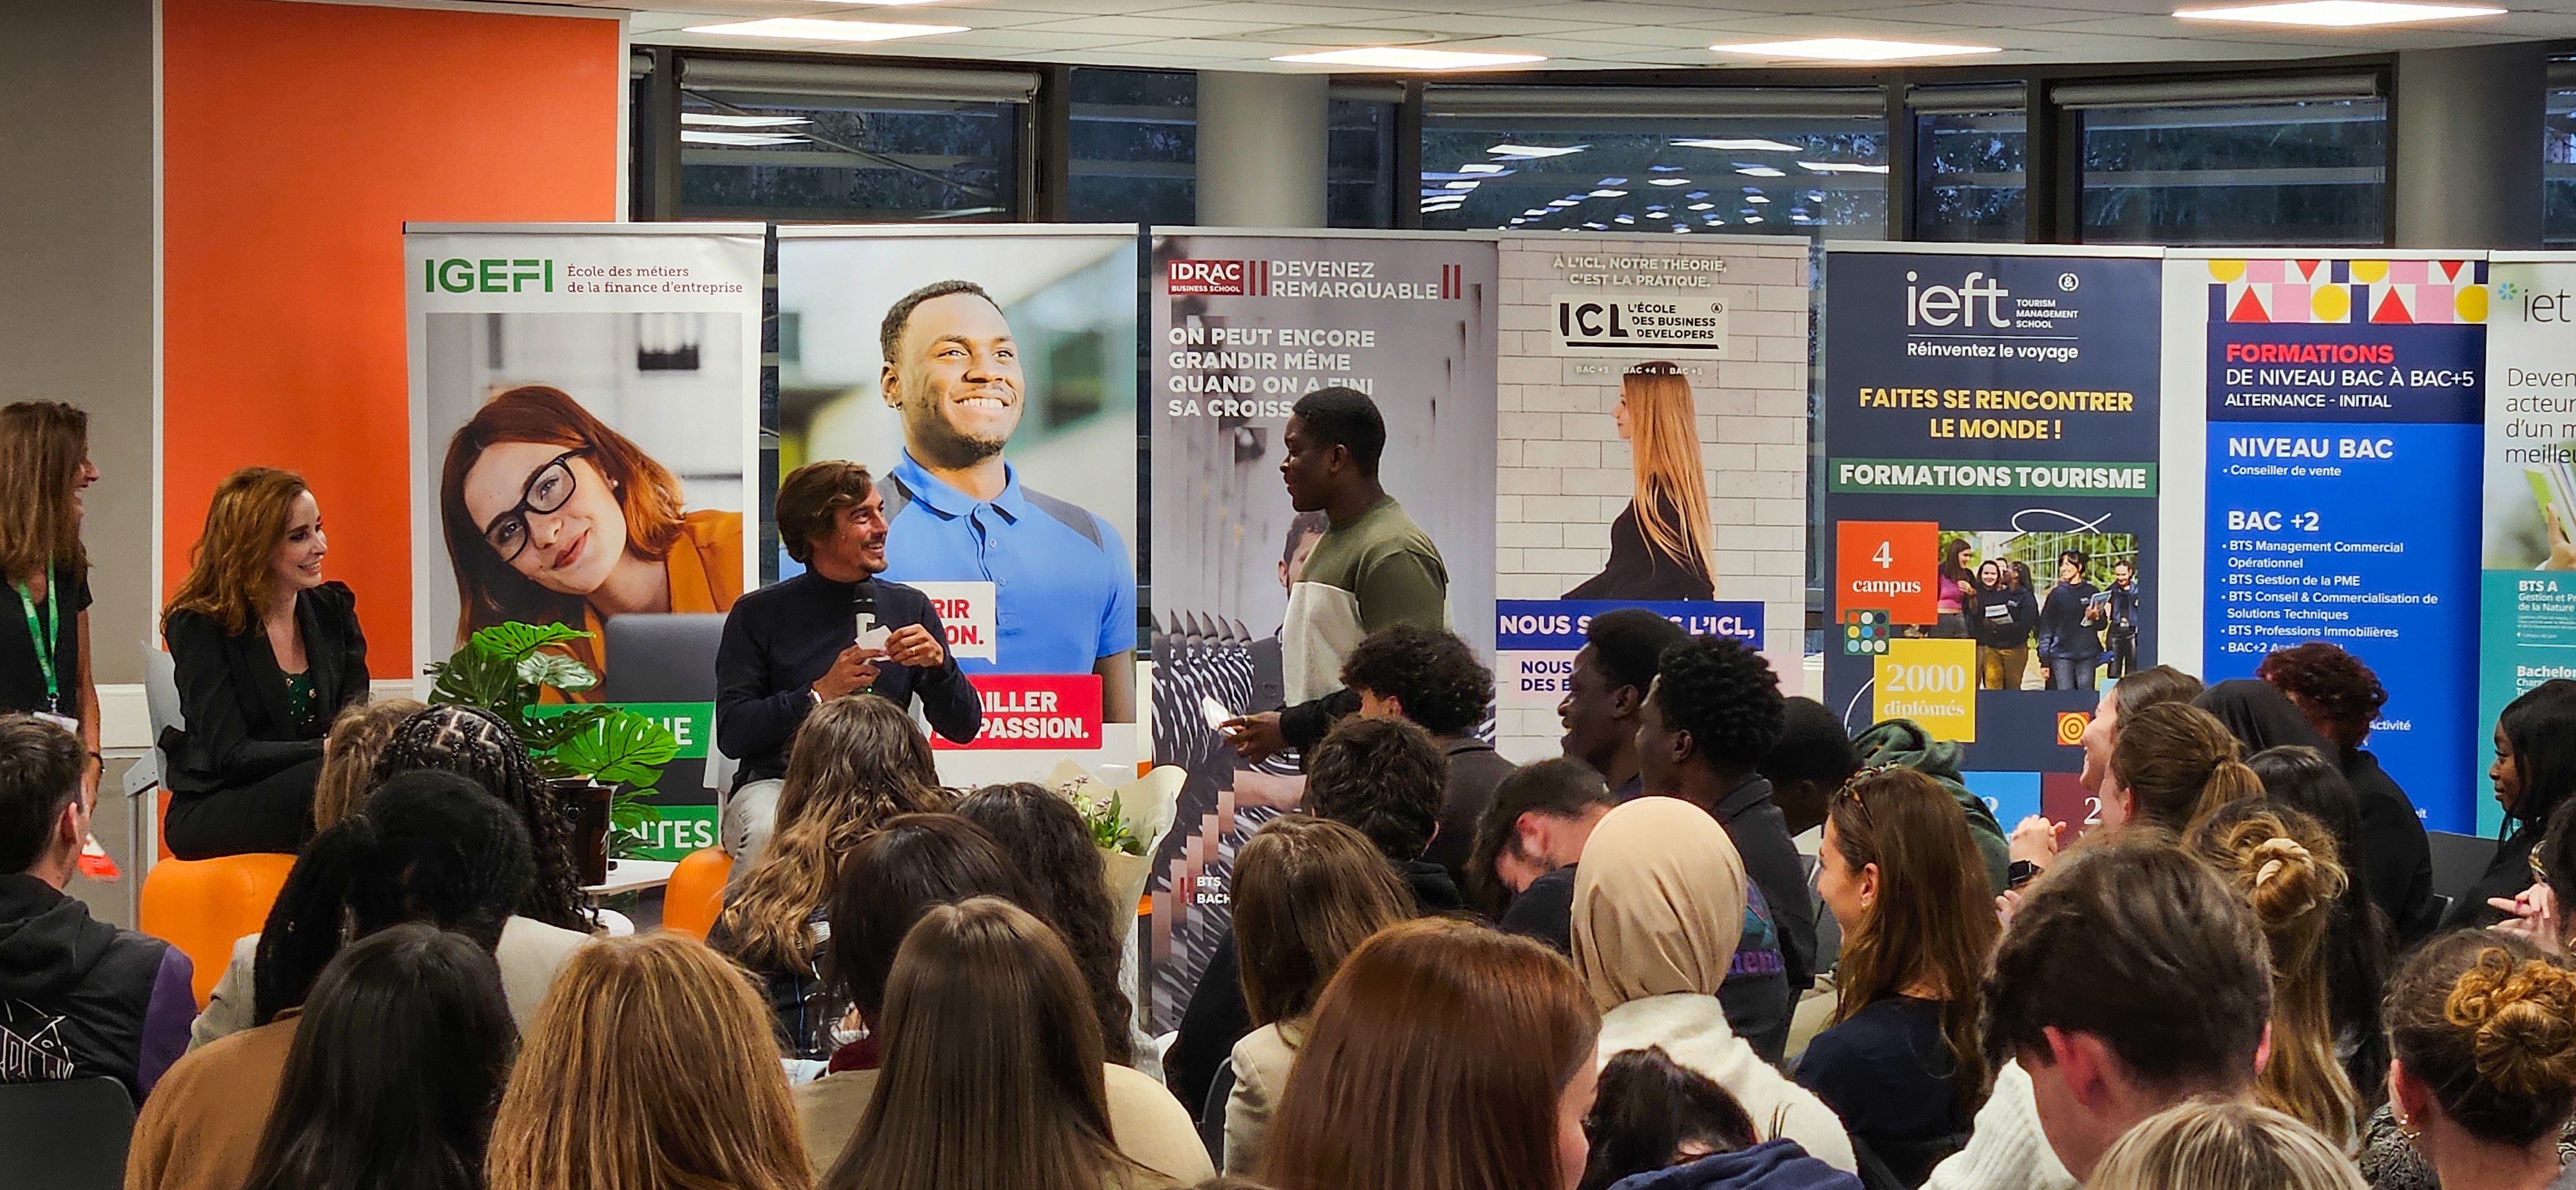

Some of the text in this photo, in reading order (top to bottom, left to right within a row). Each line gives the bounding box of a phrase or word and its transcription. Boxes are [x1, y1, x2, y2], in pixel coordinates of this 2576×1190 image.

[567, 263, 689, 277] École des métiers
[1273, 261, 1374, 278] DEVENEZ
[1553, 257, 1564, 268] À
[1610, 258, 1658, 269] NOTRE
[1662, 258, 1727, 273] THÉORIE,
[426, 259, 553, 293] IGEFI
[1171, 263, 1240, 285] IDRAC
[1569, 274, 1710, 287] C'EST LA PRATIQUE.
[567, 282, 743, 295] de la finance d'entreprise
[1273, 281, 1437, 299] REMARQUABLE
[1907, 271, 2011, 328] ieft
[2524, 289, 2571, 322] iet
[1560, 303, 1629, 337] ICL
[1632, 317, 1716, 326] DES BUSINESS
[2016, 310, 2078, 318] MANAGEMENT
[2016, 320, 2053, 328] SCHOOL
[1169, 328, 1375, 347] ON PEUT ENCORE
[1637, 330, 1714, 339] DEVELOPERS
[1169, 349, 1350, 370] GRANDIR MÊME
[1908, 343, 2078, 362] Réinventez le voyage
[2226, 345, 2394, 363] FORMATIONS
[2226, 366, 2474, 387] DE NIVEAU BAC À BAC+5
[1169, 376, 1256, 394] QUAND
[1263, 377, 1297, 393] ON
[1304, 377, 1320, 394] A
[1860, 388, 2133, 411] FAITES SE RENCONTRER
[2225, 393, 2325, 407] ALTERNANCE
[2340, 395, 2392, 408] INITIAL
[1168, 401, 1200, 417] SA
[1931, 419, 2061, 439] LE MONDE !
[2229, 438, 2394, 458] NIVEAU BAC
[1841, 464, 2146, 489] FORMATIONS TOURISME
[2231, 465, 2342, 476] Conseiller de vente
[2228, 511, 2319, 531] BAC +2
[2230, 540, 2403, 553] BTS Management Commercial
[1872, 541, 1893, 569] 4
[2228, 557, 2303, 569] Opérationnel
[1852, 580, 1921, 596] campus
[2229, 574, 2360, 586] BTS Gestion de la PME
[2519, 581, 2558, 592] BTS A
[2229, 592, 2438, 603] BTS Conseil & Commercialisation de
[2519, 593, 2553, 601] Gestion
[2555, 594, 2564, 602] et
[2227, 609, 2349, 621] Solutions Techniques
[2543, 603, 2575, 612] Nature
[1501, 616, 1571, 634] NOUS
[2228, 625, 2399, 638] BTS Professions Immobilières
[2228, 643, 2267, 652] BAC+2
[1522, 661, 1572, 674] NOUS
[1521, 679, 1555, 691] DES
[1885, 664, 1965, 692] 2000
[1883, 700, 1965, 717] diplômés
[1197, 876, 1221, 887] BTS
